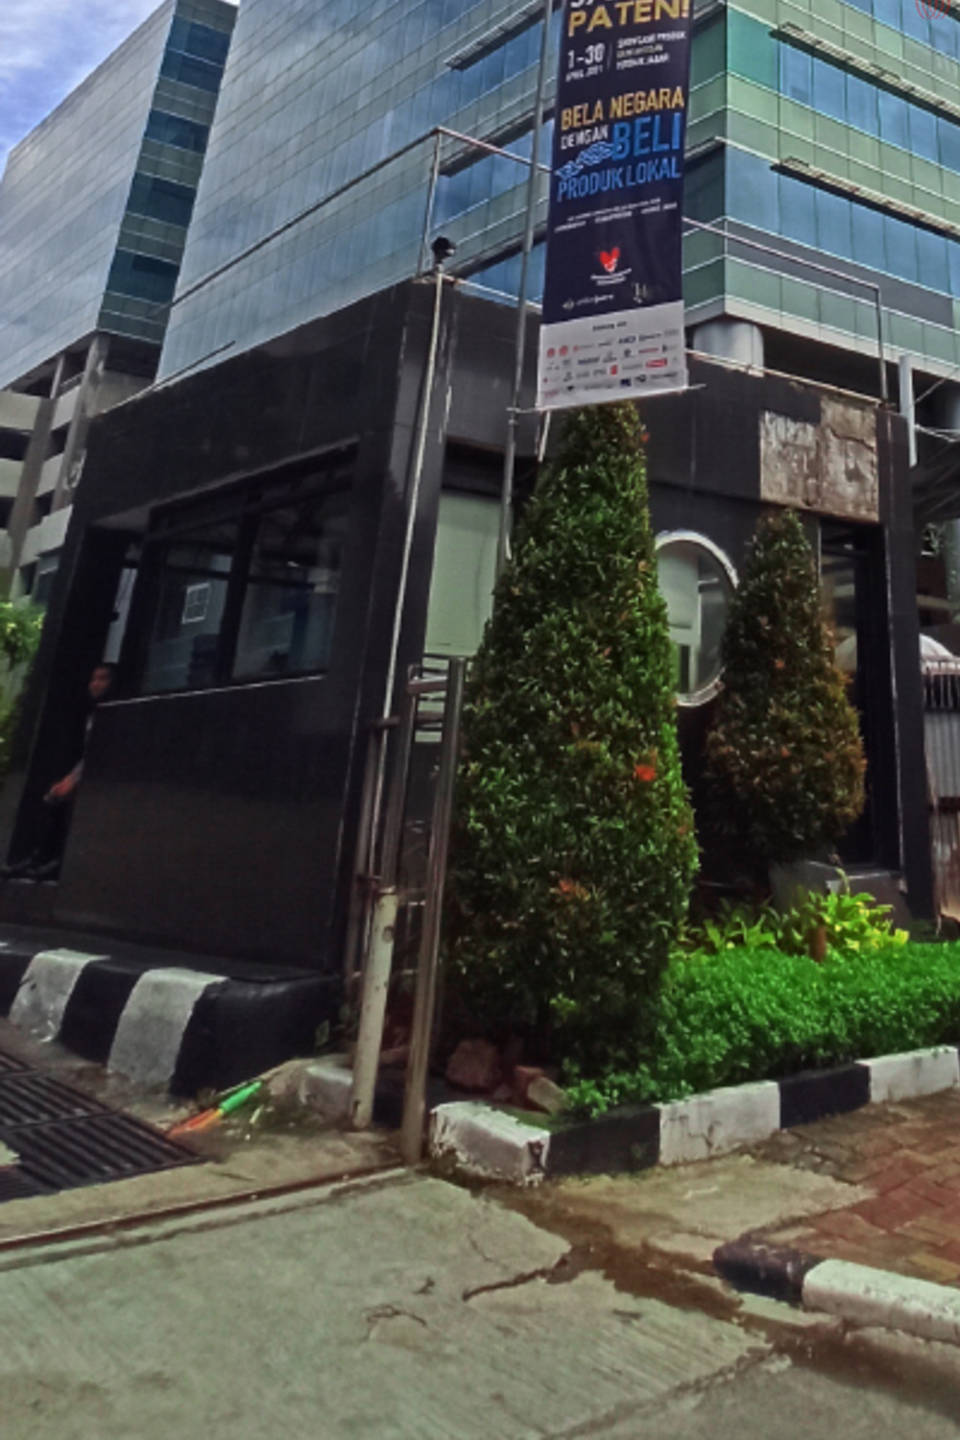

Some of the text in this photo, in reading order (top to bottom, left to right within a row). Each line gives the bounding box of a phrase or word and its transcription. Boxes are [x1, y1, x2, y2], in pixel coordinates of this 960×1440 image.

[567, 42, 605, 70] 1-30
[561, 86, 685, 131] BELA NEGARA
[560, 125, 609, 150] DENGAN
[612, 111, 682, 161] BELI
[556, 156, 682, 202] PRODUK LOKAL
